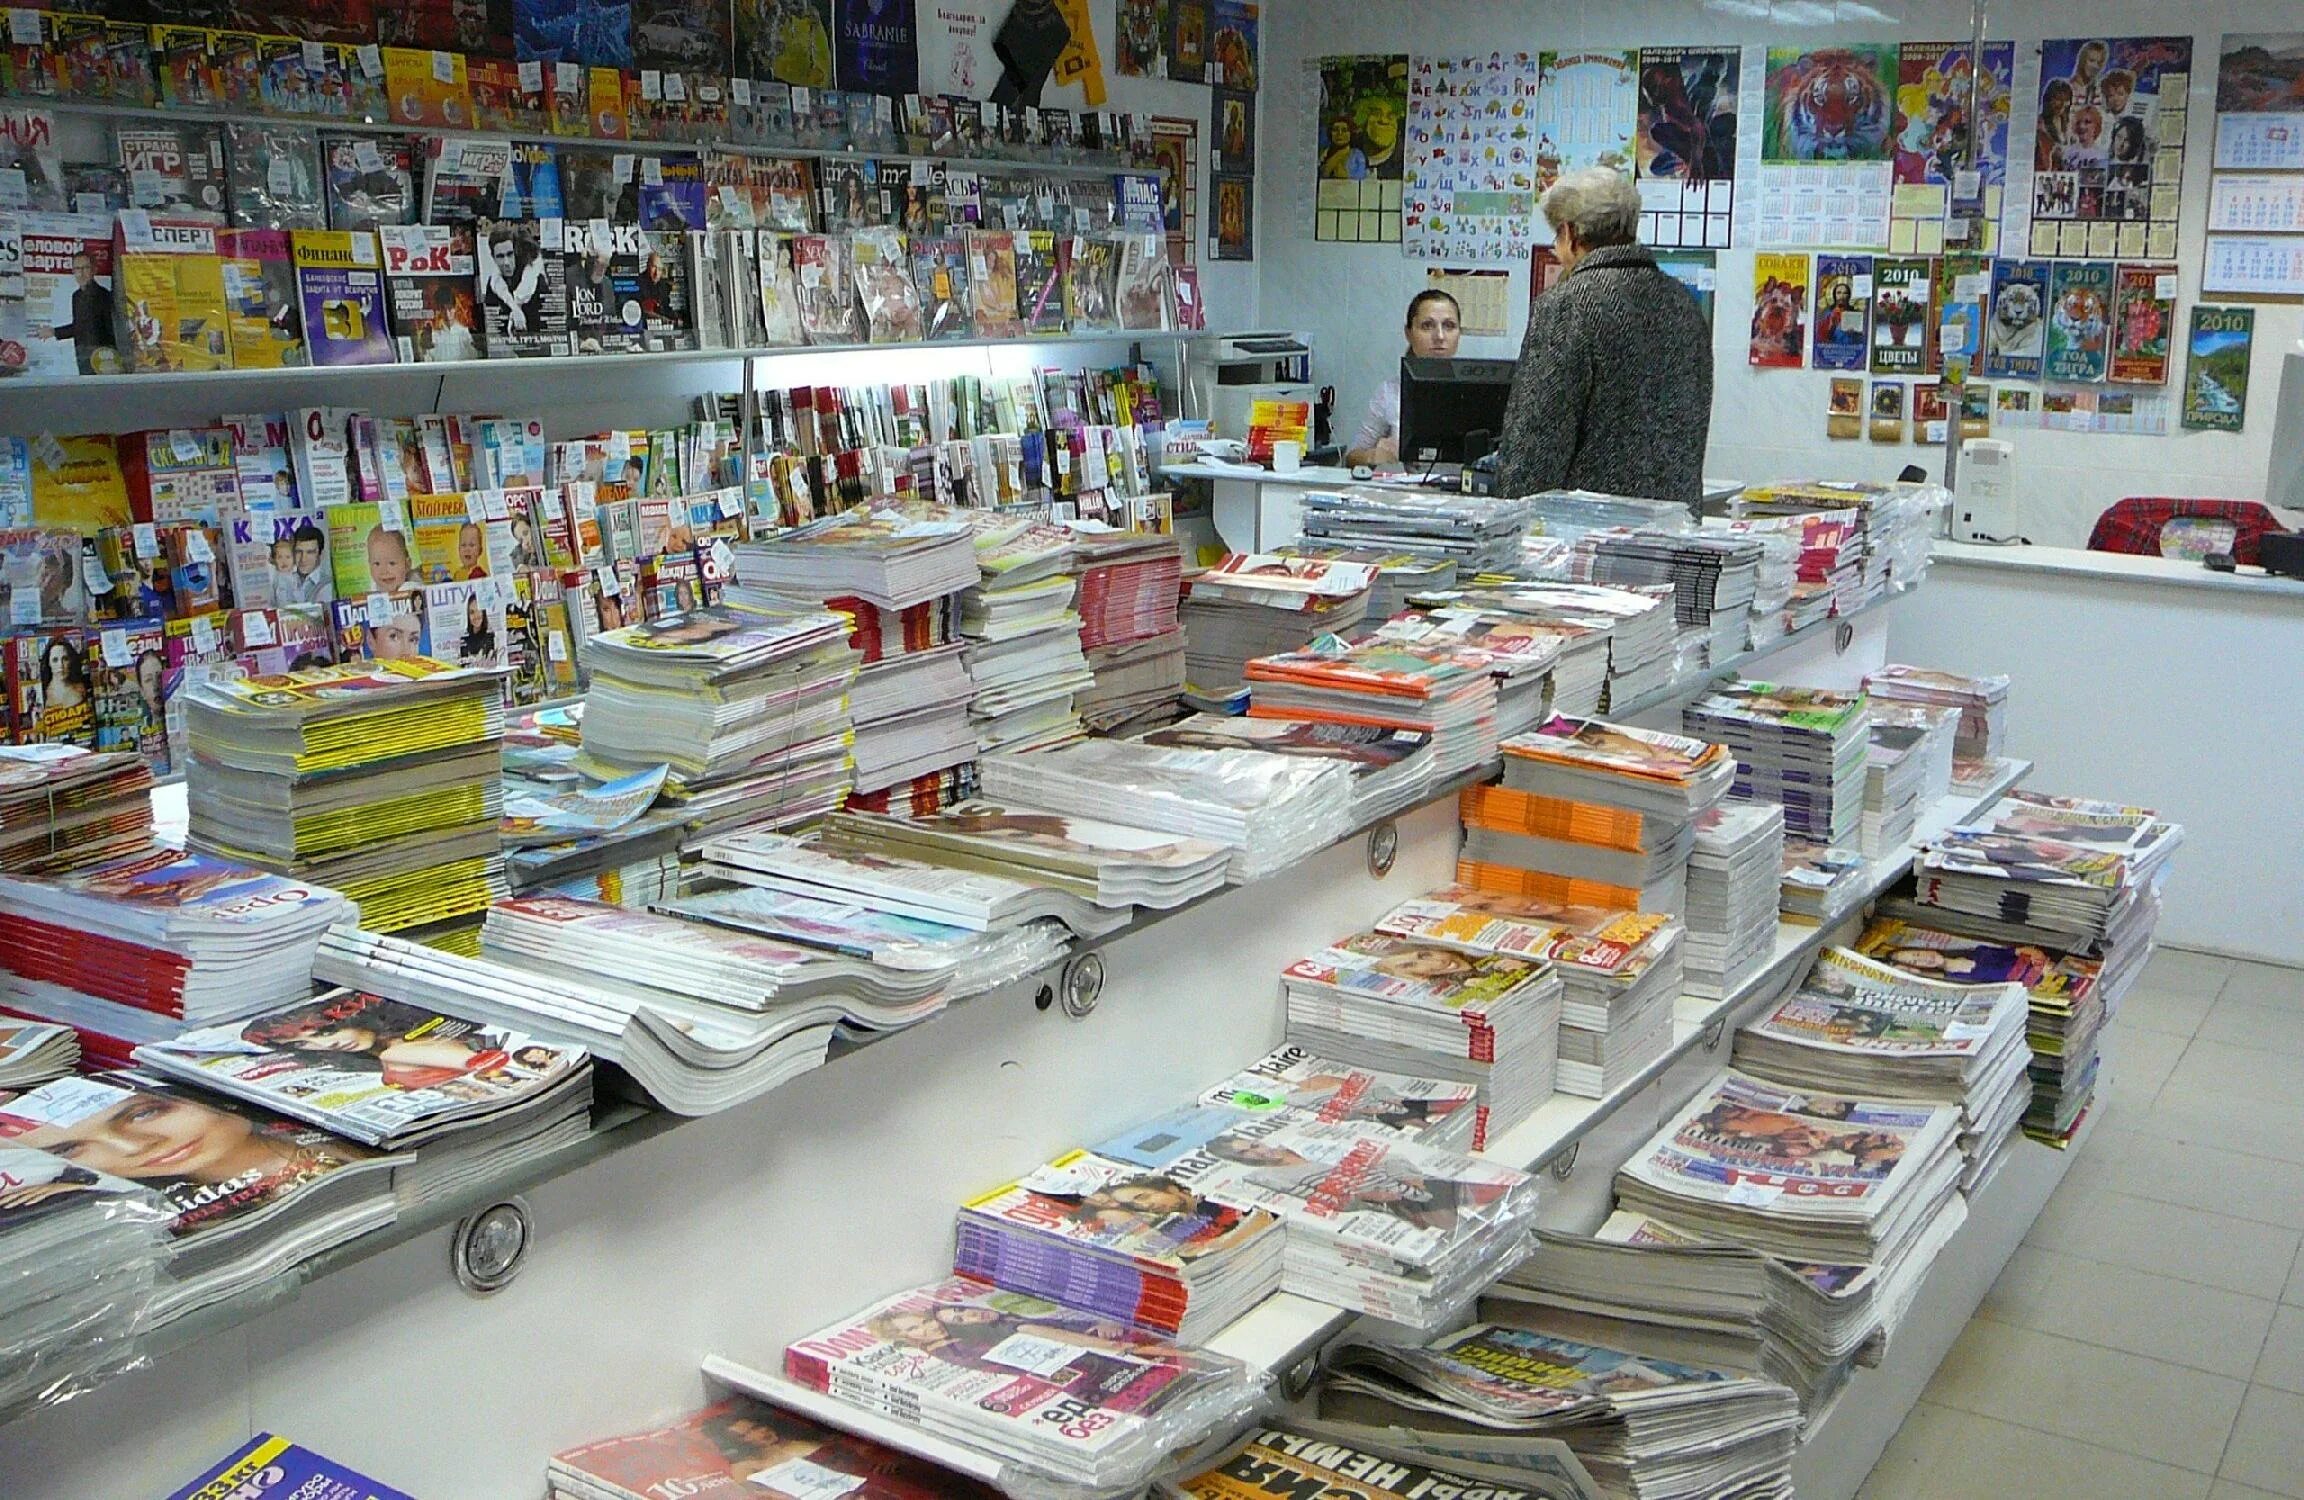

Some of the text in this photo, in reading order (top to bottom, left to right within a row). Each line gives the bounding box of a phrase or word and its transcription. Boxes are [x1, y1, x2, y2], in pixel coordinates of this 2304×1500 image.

[124, 141, 177, 151] СТРАНА
[152, 228, 209, 243] СПЕРТ
[24, 239, 84, 256] еловой
[1758, 258, 1804, 270] СОБАКИ
[1883, 269, 1920, 284] 2010
[2066, 269, 2100, 282] 2010
[2130, 274, 2156, 287] 201
[575, 285, 595, 301] JON
[572, 300, 603, 318] LORD
[2201, 313, 2244, 331] 2010
[1879, 351, 1918, 366] ЦВЕТЫ
[2062, 351, 2089, 363] ГОД
[2054, 362, 2095, 377] ТИГРА
[2186, 410, 2237, 425] ПРИРОДА
[1164, 1148, 1219, 1180] mar
[1059, 1411, 1115, 1439] без
